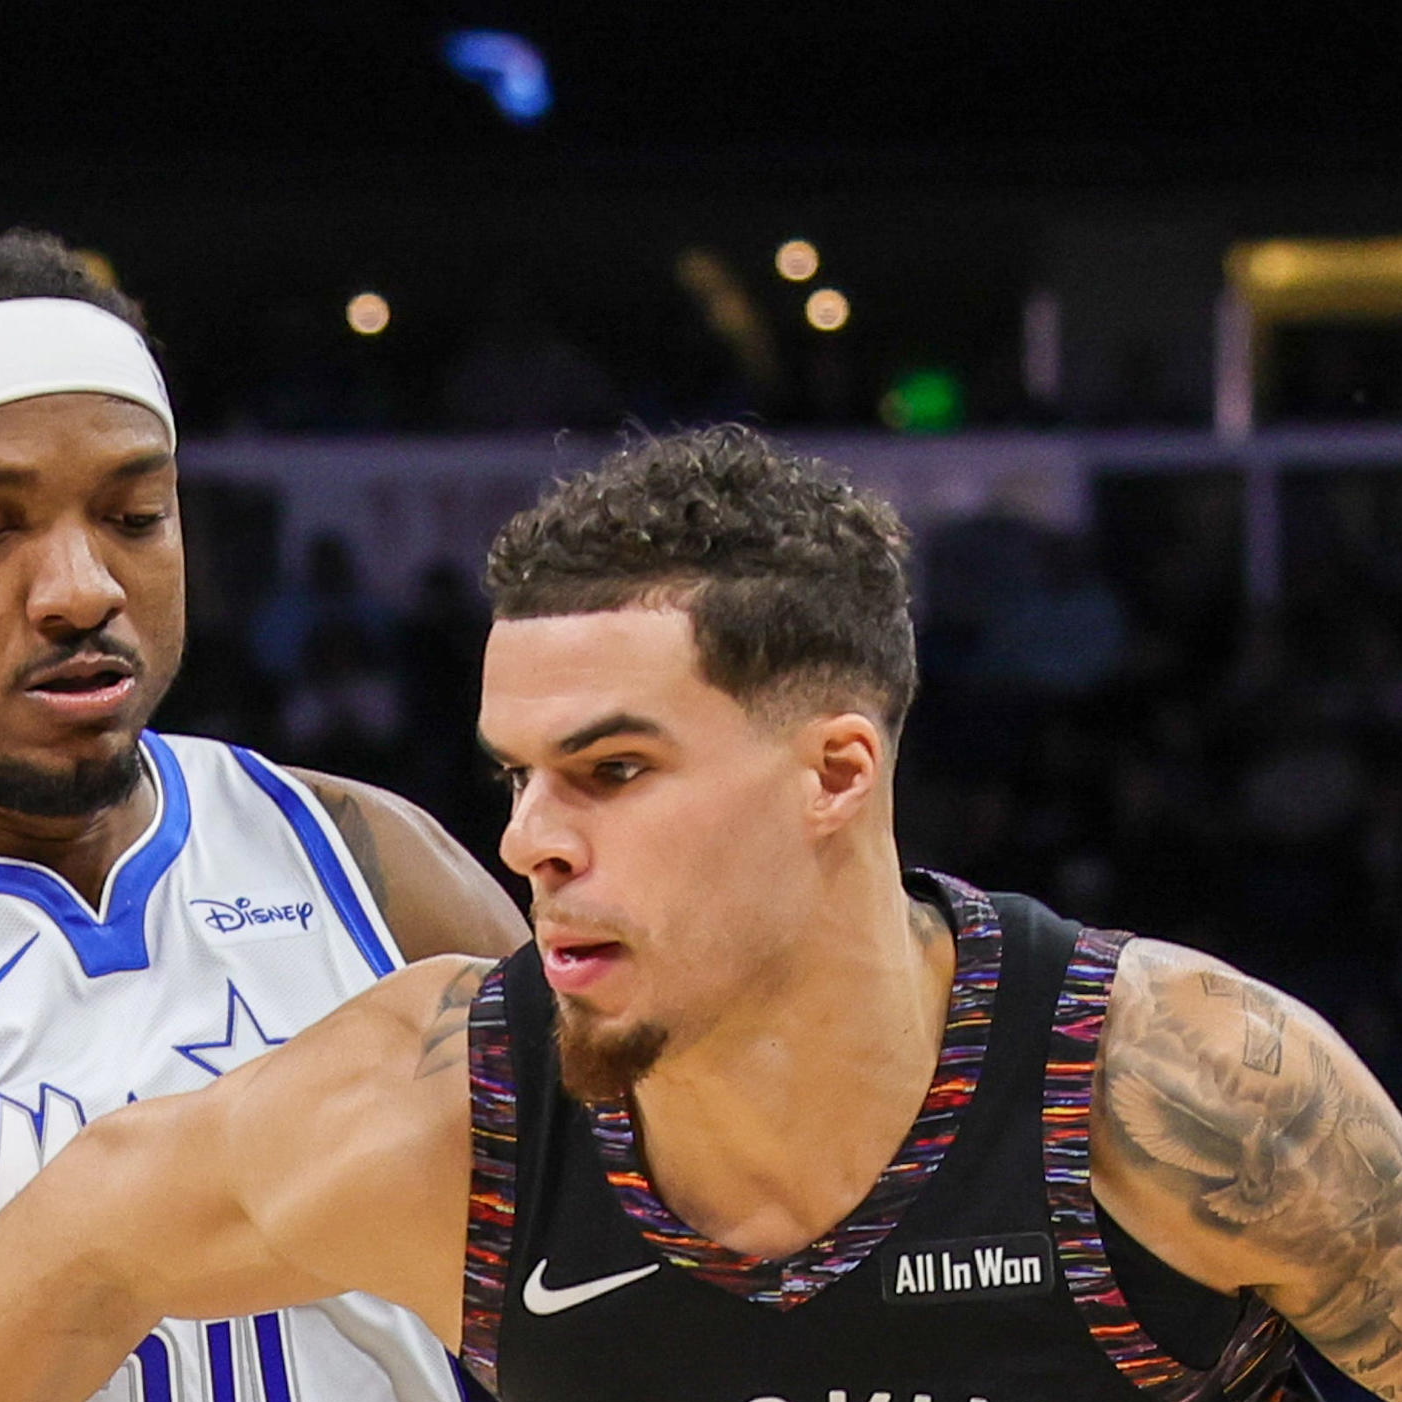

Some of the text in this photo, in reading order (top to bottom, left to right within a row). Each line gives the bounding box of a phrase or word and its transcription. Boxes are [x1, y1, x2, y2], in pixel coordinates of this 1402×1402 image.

[189, 897, 314, 933] Disney
[895, 1246, 1042, 1295] All In Won
